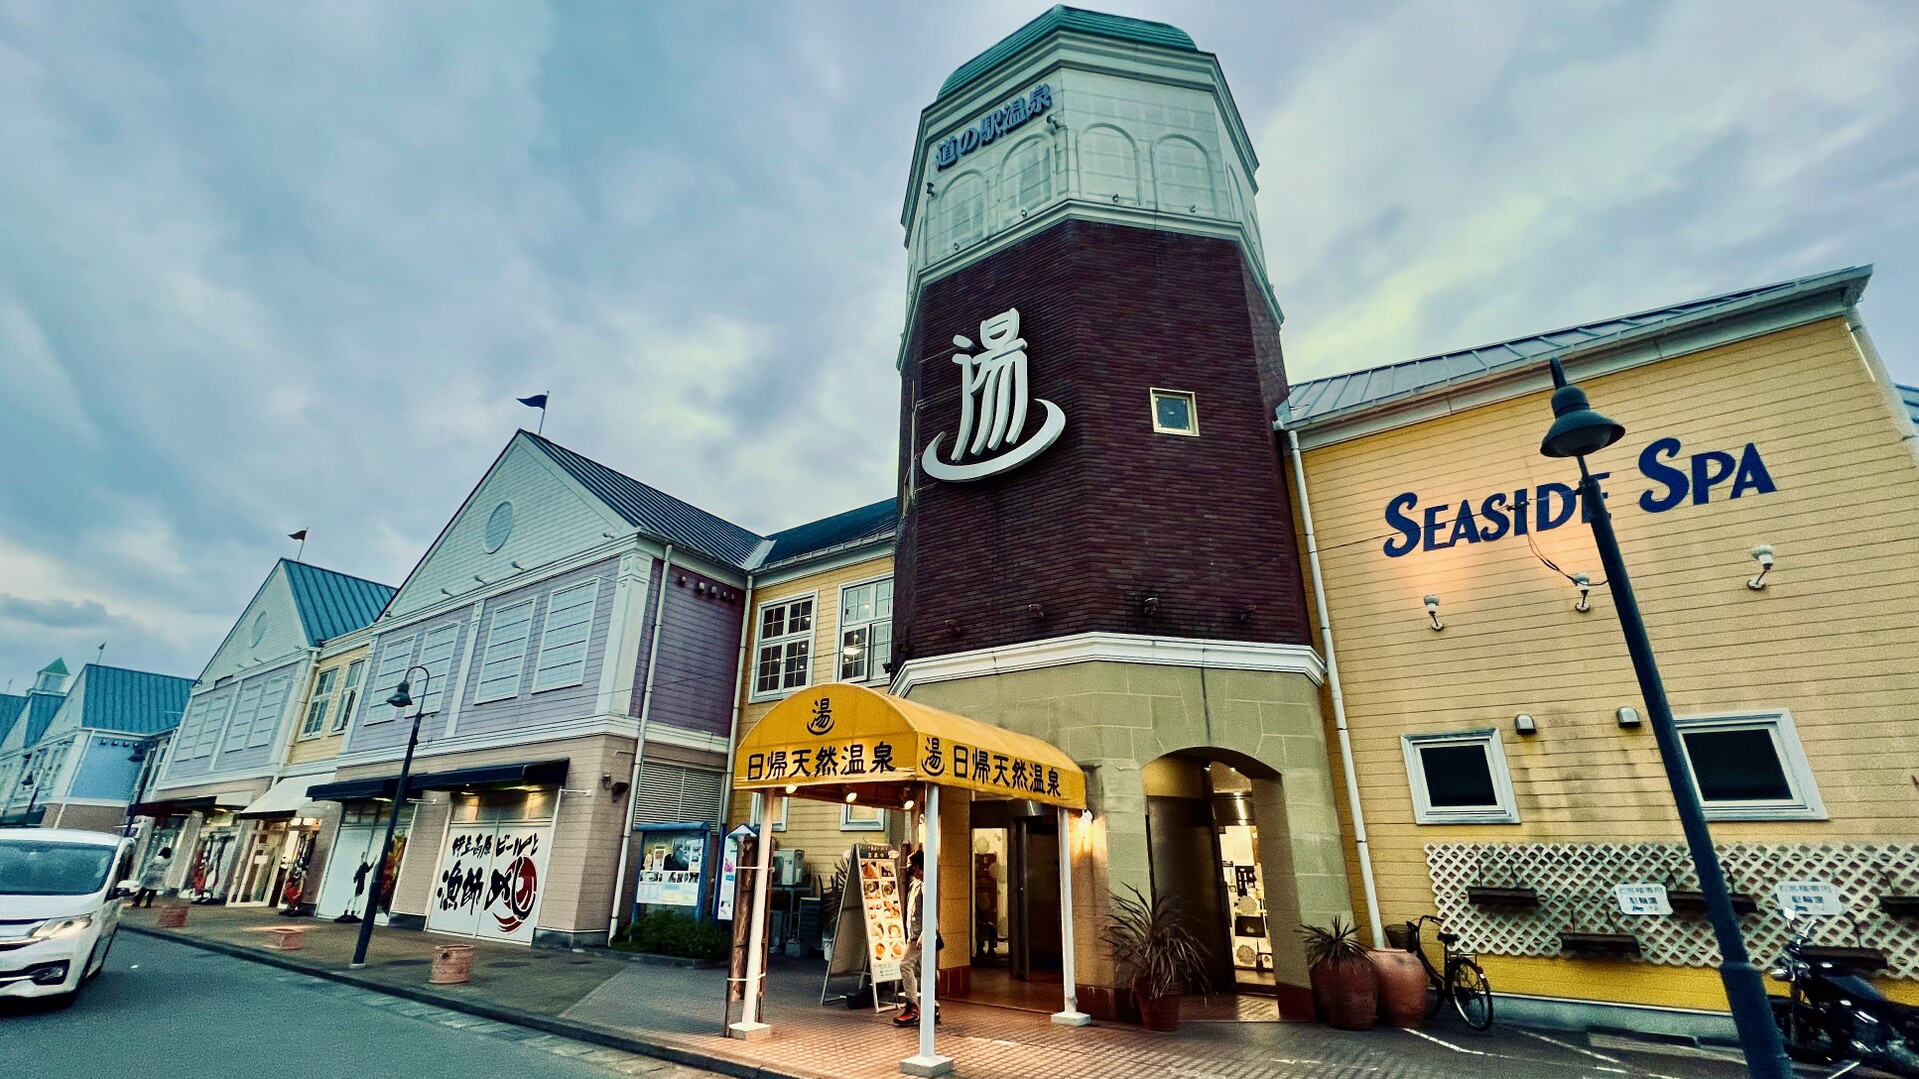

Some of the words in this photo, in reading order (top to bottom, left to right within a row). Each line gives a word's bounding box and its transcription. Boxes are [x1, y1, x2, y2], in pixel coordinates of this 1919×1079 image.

[936, 83, 1052, 172] 道の駅温泉
[947, 307, 1033, 465] 湯
[1637, 437, 1777, 513] SPA
[809, 698, 834, 732] 湯
[748, 741, 896, 781] 日帰天然温泉
[922, 737, 943, 772] 湯
[953, 745, 1061, 797] 日帰天然温泉
